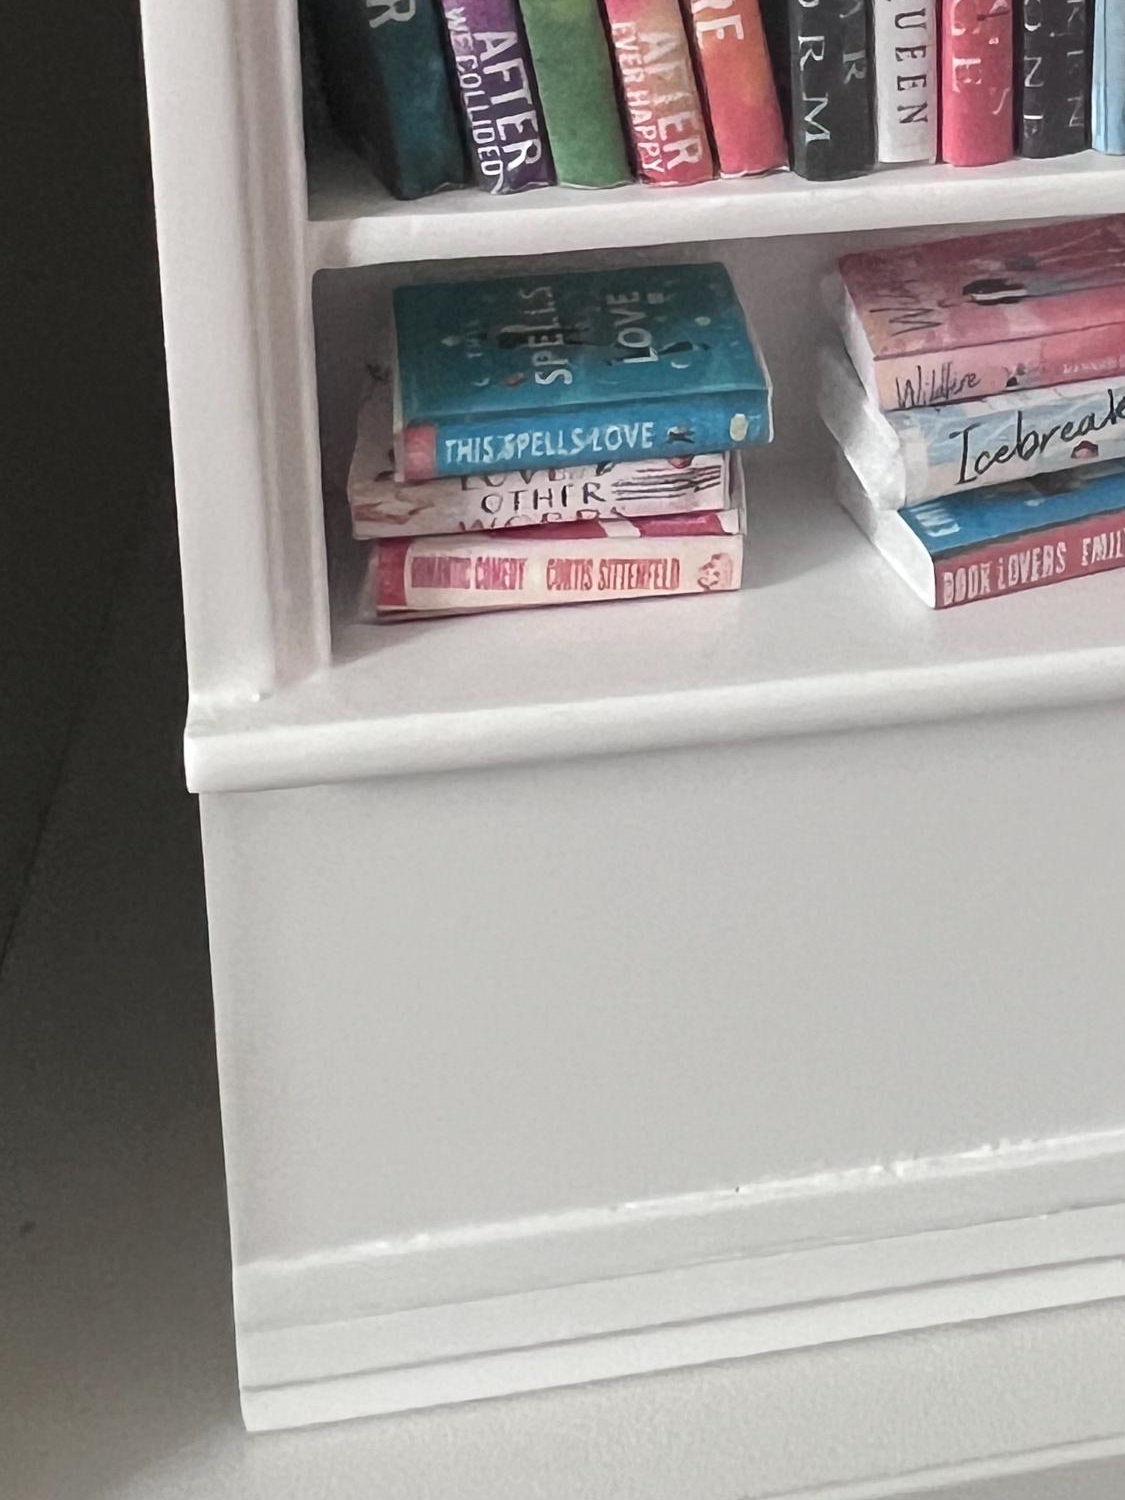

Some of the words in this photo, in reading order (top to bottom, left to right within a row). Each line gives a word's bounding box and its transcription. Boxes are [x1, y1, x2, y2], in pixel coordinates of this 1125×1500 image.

[444, 6, 474, 53] WE
[611, 21, 645, 84] EVER
[454, 55, 504, 177] COLLIDED
[474, 30, 543, 171] AFTER
[625, 88, 666, 174] HAPPY
[636, 30, 703, 171] AFTER
[521, 285, 574, 387] SPELLS
[606, 290, 659, 365] LOVE
[445, 437, 494, 465] THIS
[501, 426, 586, 461] SPELLS
[590, 421, 655, 453] LOVE
[996, 540, 1067, 592] LOVERS
